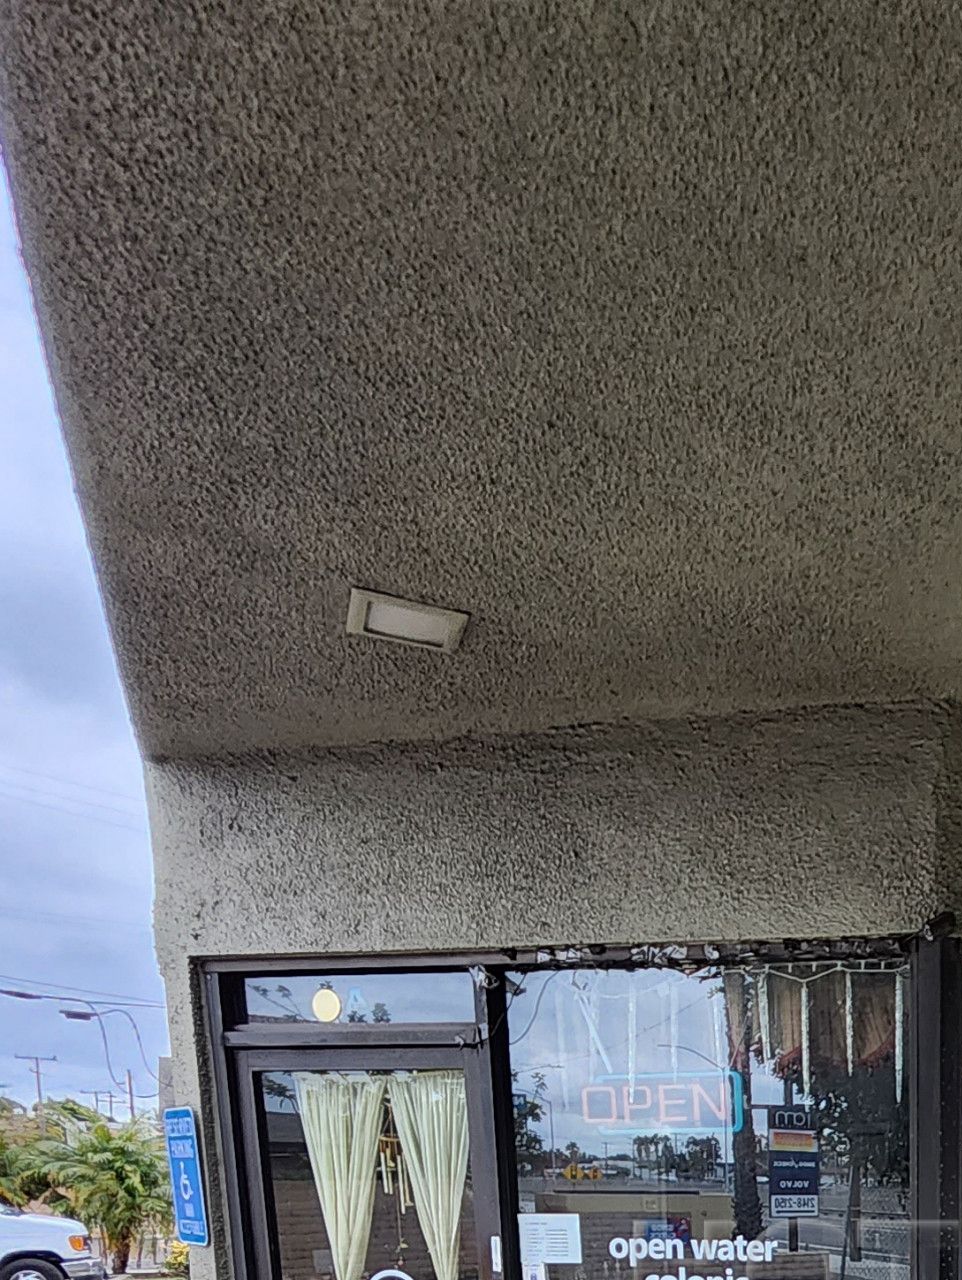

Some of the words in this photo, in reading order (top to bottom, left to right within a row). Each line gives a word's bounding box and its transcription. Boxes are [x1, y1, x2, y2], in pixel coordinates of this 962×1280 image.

[580, 1080, 727, 1126] OPEN
[608, 1237, 684, 1267] open
[690, 1235, 778, 1262] water
